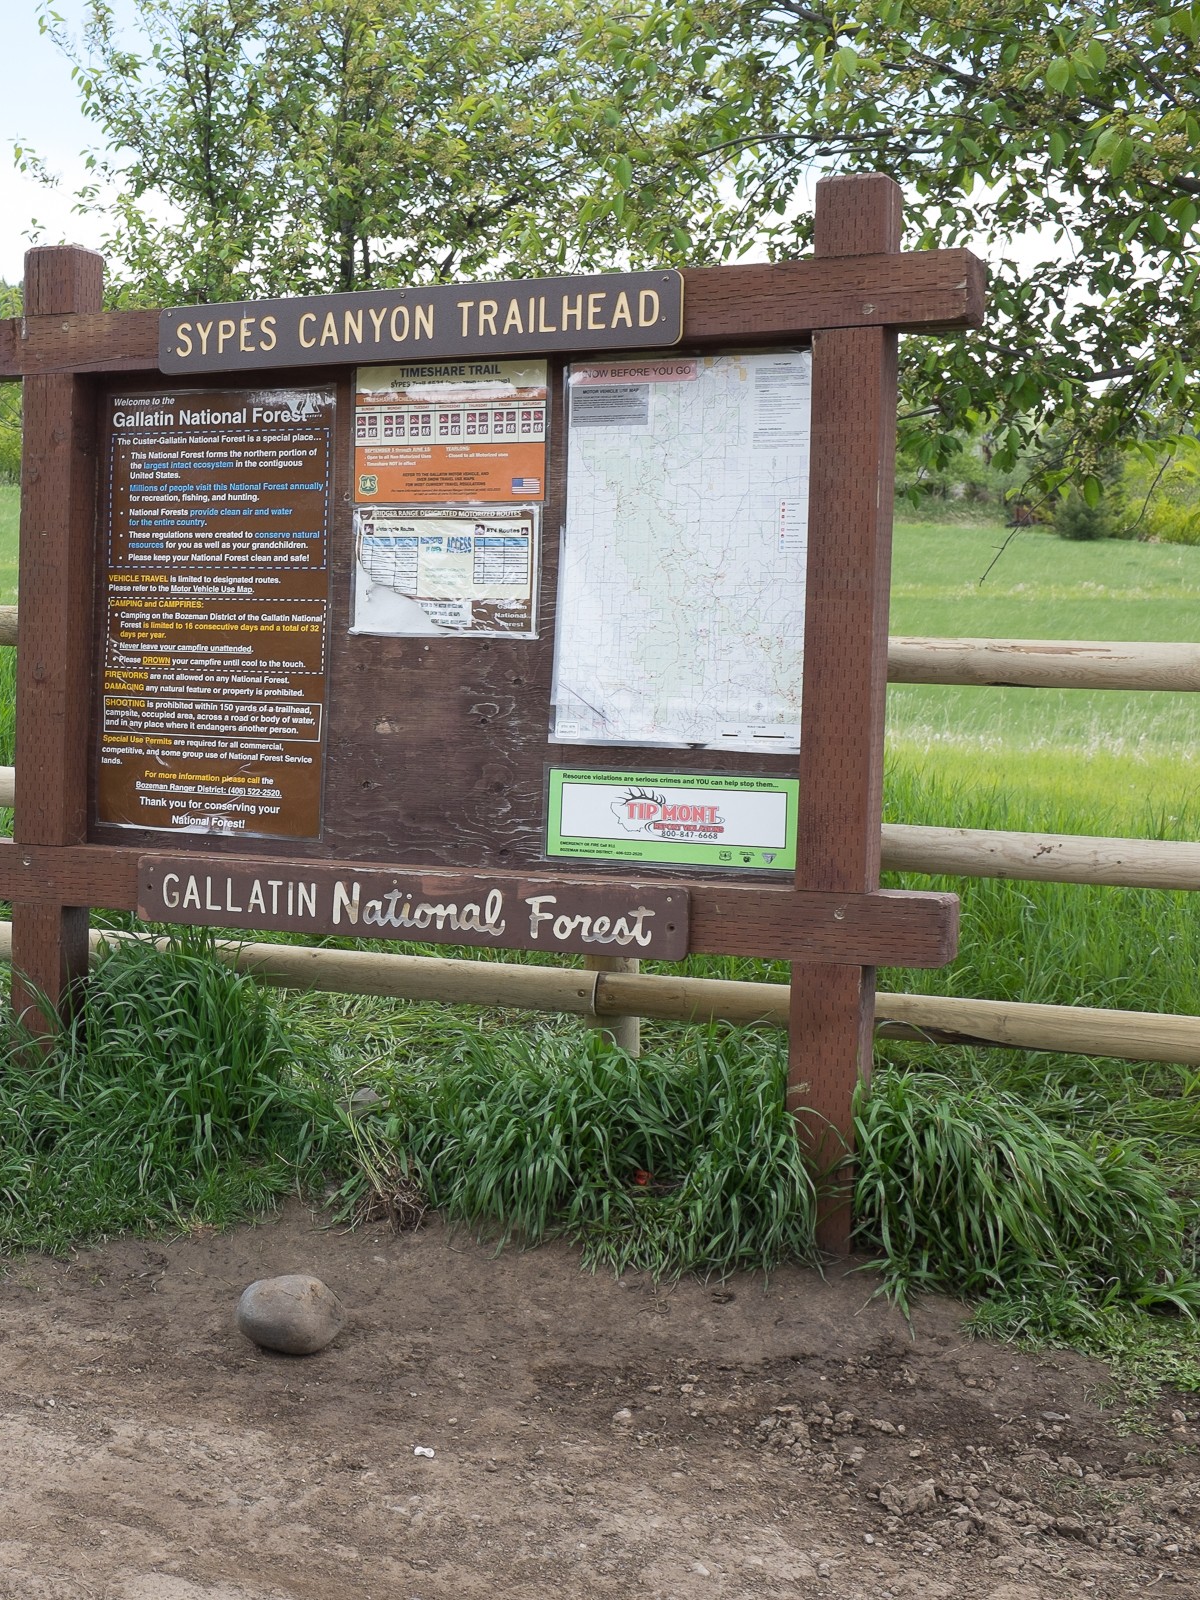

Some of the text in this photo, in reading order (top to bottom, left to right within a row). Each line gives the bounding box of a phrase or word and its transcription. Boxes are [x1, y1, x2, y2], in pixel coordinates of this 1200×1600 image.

[176, 289, 660, 358] SYPES CANYON TRAILHEAD
[400, 364, 501, 377] TIMESHARE TRAIL
[611, 368, 650, 377] BEFORE
[652, 366, 673, 375] YOU
[676, 366, 690, 374] GO
[114, 398, 150, 406] Welcome
[113, 407, 307, 427] Gallatin National Forest
[132, 436, 186, 444] Custer-Gallatin
[188, 435, 219, 443] National
[262, 434, 290, 443] special
[278, 449, 306, 457] portion
[143, 462, 168, 470] largest
[193, 461, 233, 469] ecosystem
[258, 459, 302, 468] contiguous
[169, 484, 193, 492] people
[290, 483, 323, 491] annually
[190, 508, 218, 516] provide
[153, 554, 170, 562] keep
[213, 576, 253, 584] designated
[105, 671, 148, 680] FIREWORKS
[105, 682, 143, 691] DAMAGING
[186, 685, 211, 693] feature
[222, 687, 253, 695] property
[264, 688, 305, 697] prohibited.
[106, 699, 145, 707] SHOOTING
[155, 701, 193, 710] prohibited
[194, 702, 217, 710] within
[235, 704, 258, 712] yards
[275, 705, 312, 714] trailhead,
[136, 782, 282, 797] Bozeman Ranger District: (406) 522-2520.
[140, 797, 280, 815] Thank you for conserving your
[627, 803, 720, 824] TIP MONT
[172, 815, 245, 829] National Forest!
[661, 830, 718, 840] 800-847-6668
[162, 873, 656, 947] GALLATIN National Forest
